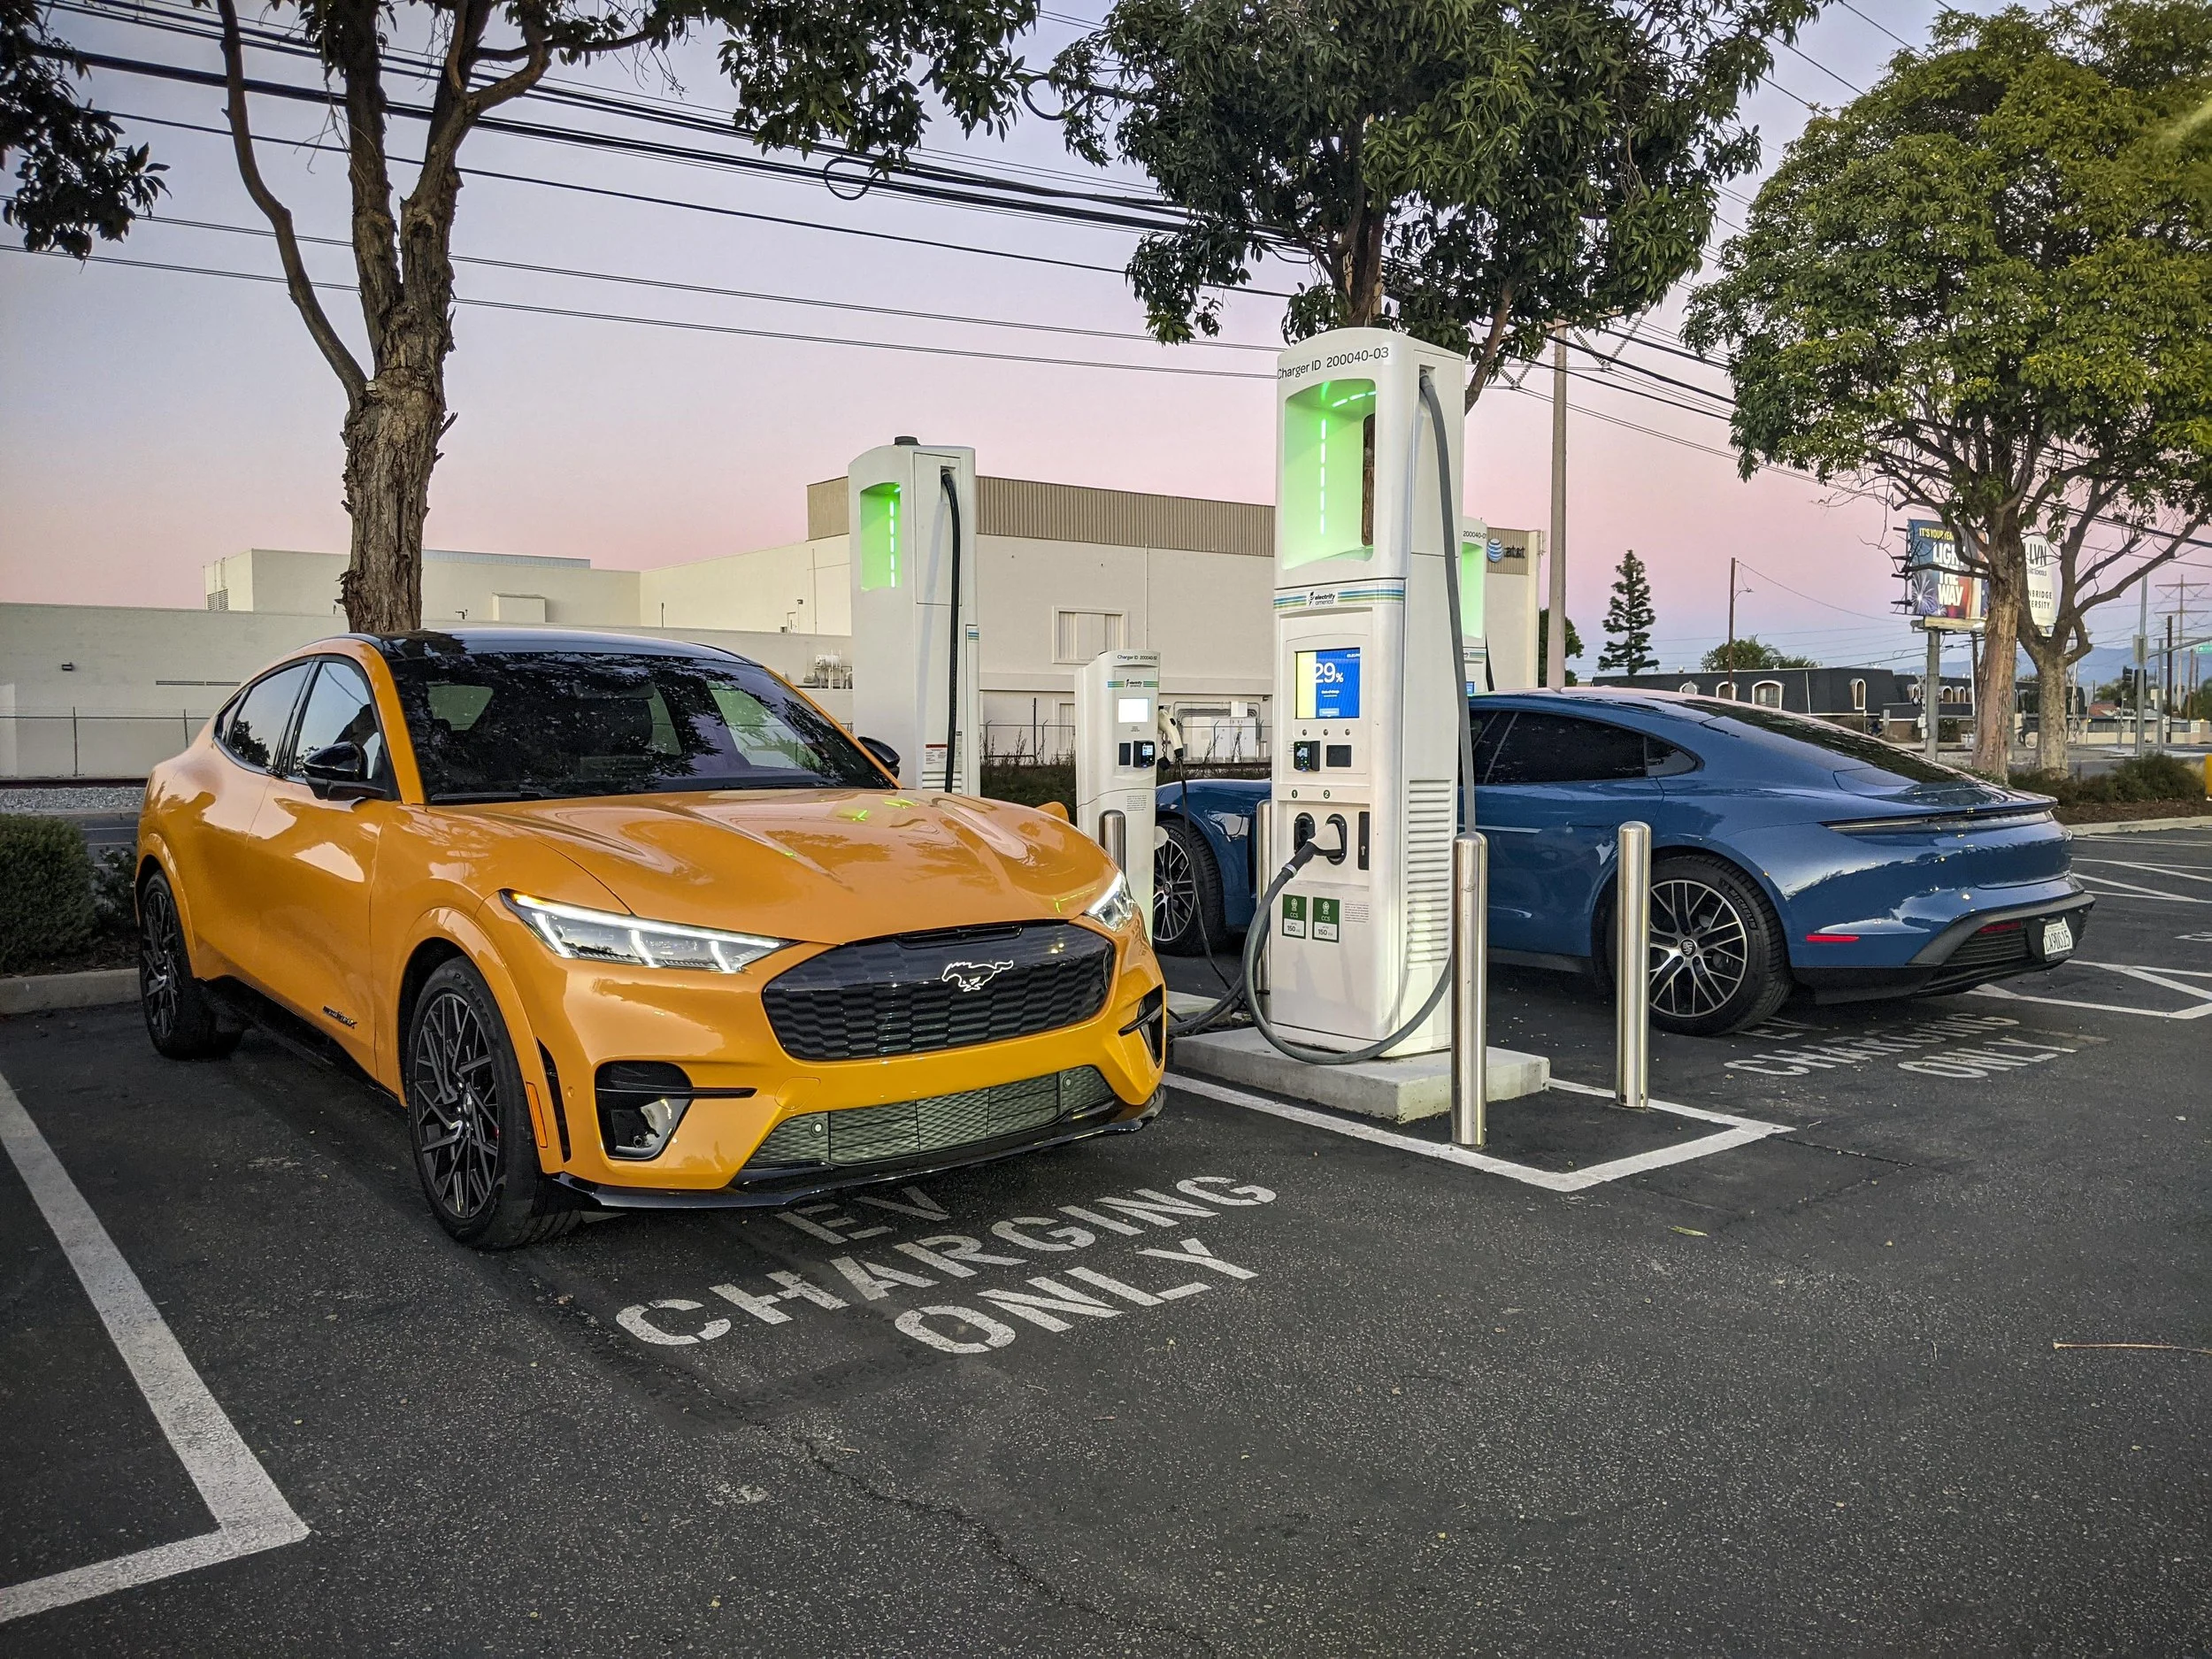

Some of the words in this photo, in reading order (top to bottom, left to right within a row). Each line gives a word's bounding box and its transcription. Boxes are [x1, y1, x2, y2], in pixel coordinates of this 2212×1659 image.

[1277, 365, 1310, 380] Charger
[1311, 359, 1321, 373] ID
[1326, 347, 1389, 368] 200040-03
[1938, 584, 1964, 606] WAY
[1315, 662, 1344, 684] 29%
[774, 1187, 950, 1245] EV
[616, 1175, 1278, 1346] CHARGING
[895, 1238, 1260, 1355] ONLY
